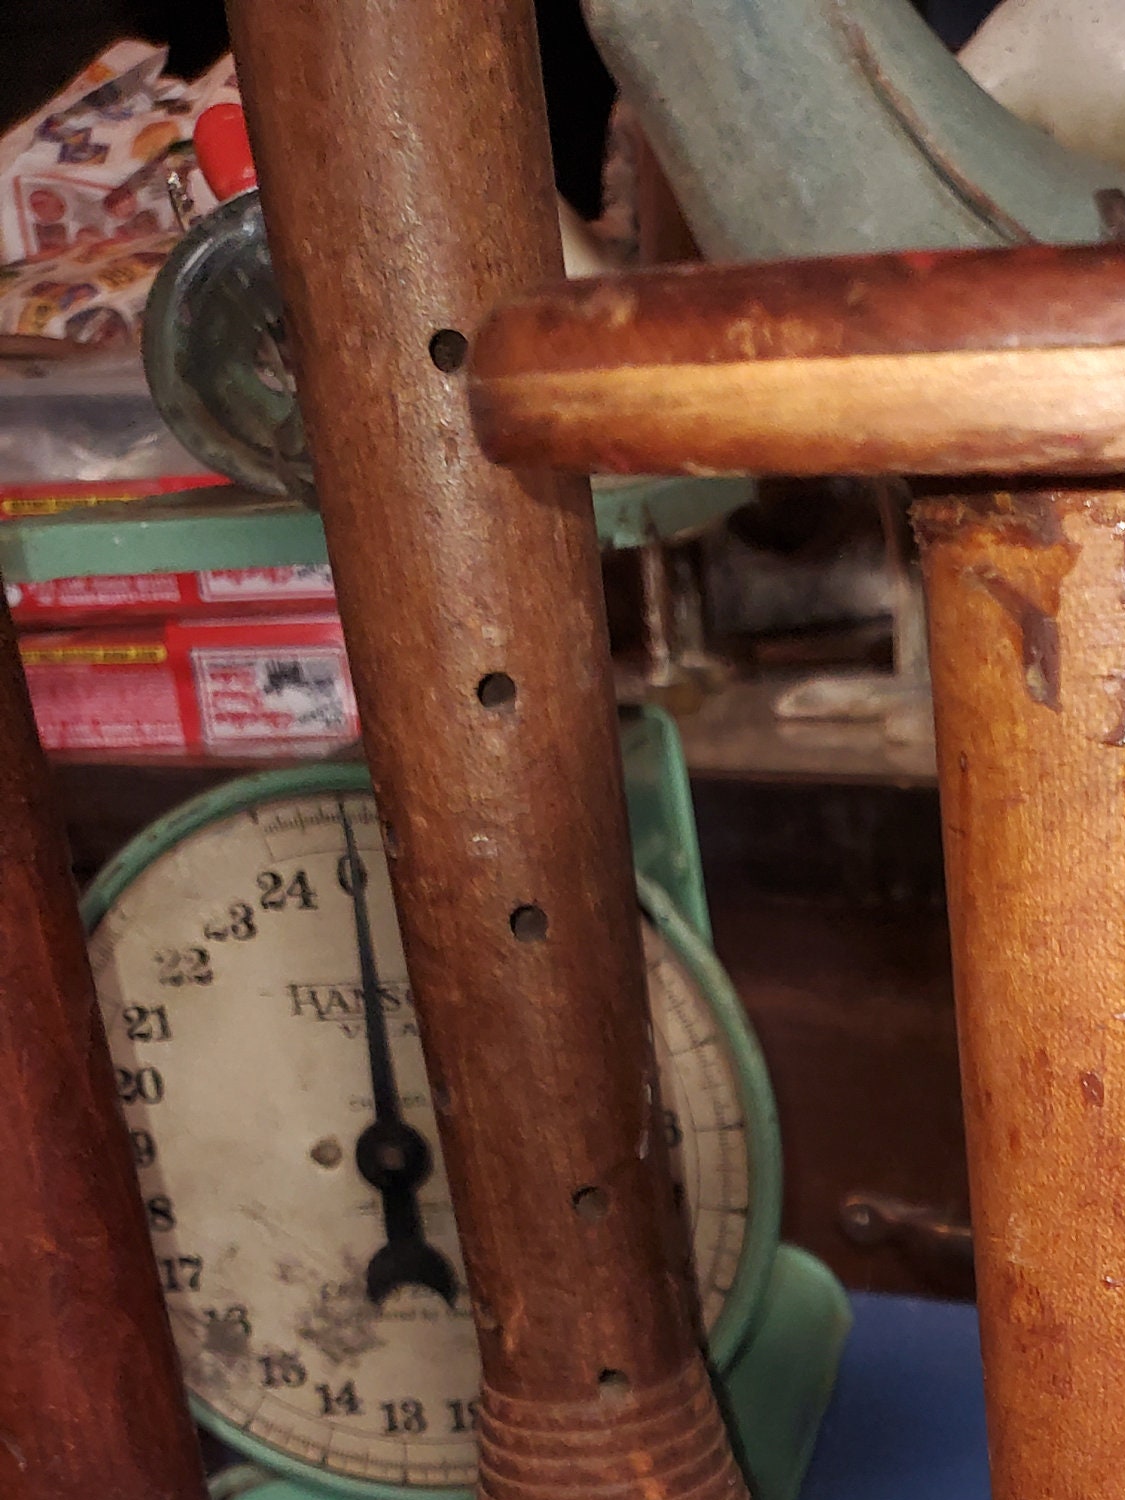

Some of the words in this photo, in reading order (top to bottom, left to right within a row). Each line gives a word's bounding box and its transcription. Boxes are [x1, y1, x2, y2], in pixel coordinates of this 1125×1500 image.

[256, 870, 319, 911] 24
[122, 1005, 172, 1042] 21
[315, 1380, 362, 1416] 14
[381, 1400, 428, 1434] 13
